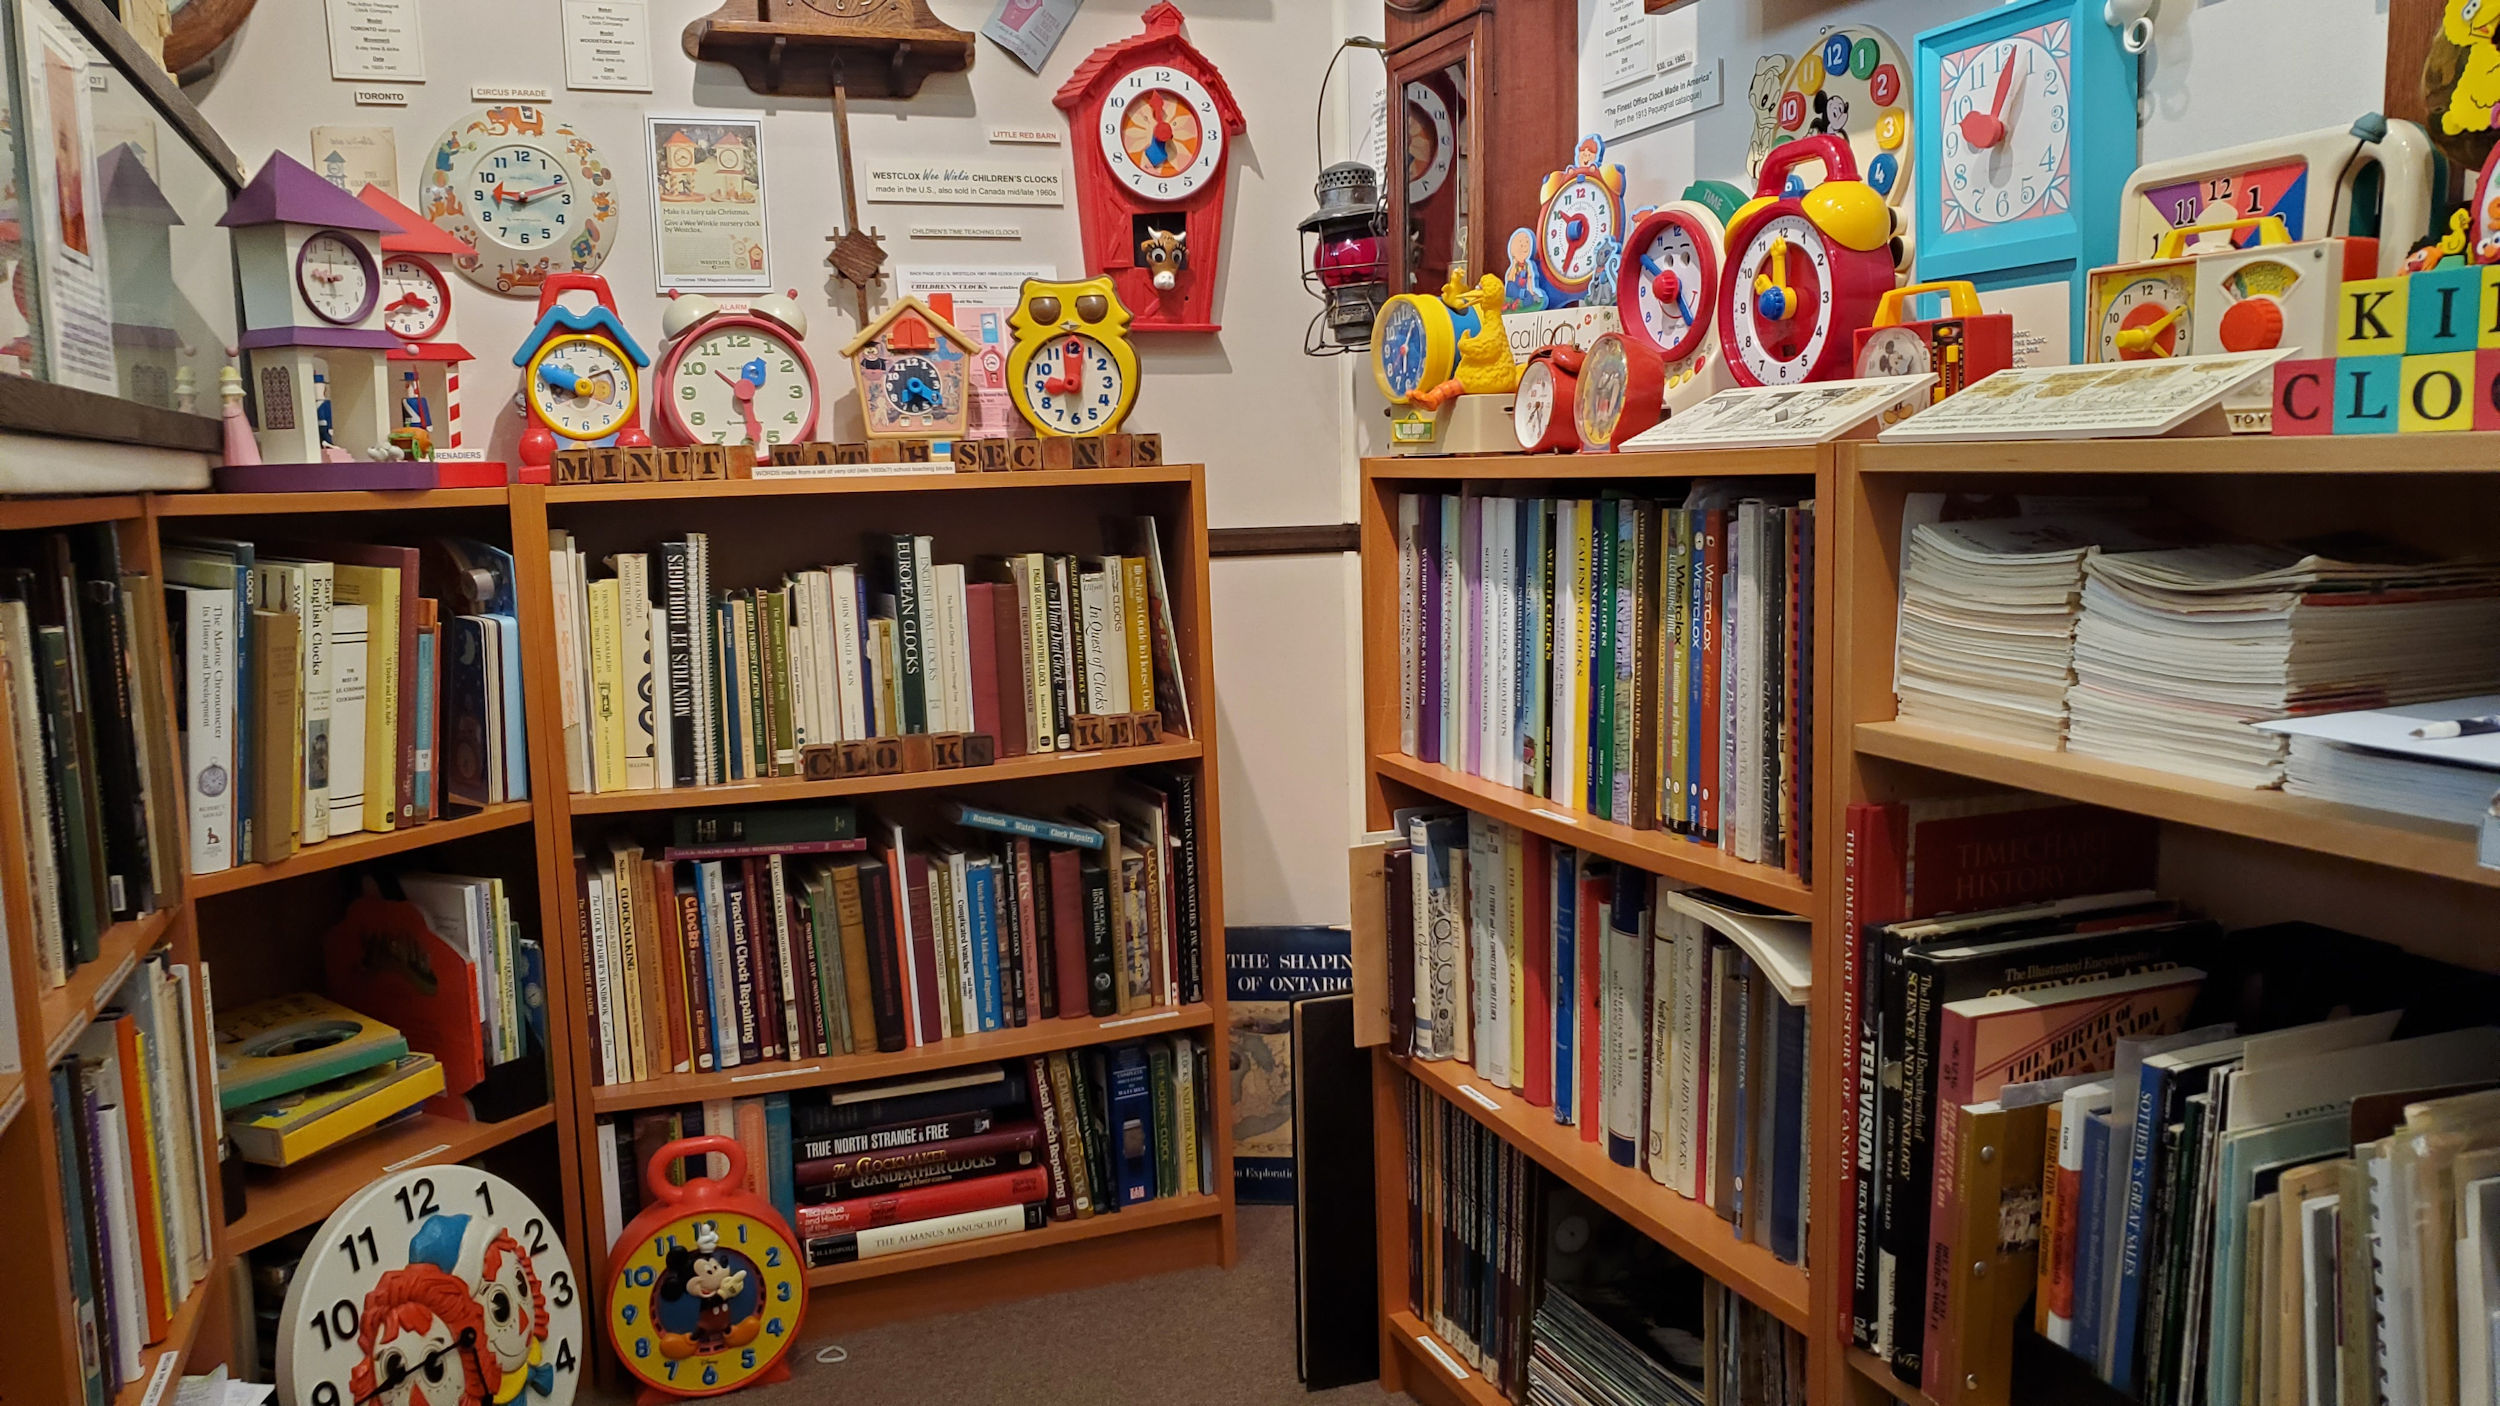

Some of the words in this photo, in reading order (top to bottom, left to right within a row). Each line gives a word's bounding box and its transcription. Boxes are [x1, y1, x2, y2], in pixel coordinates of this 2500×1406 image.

[1826, 42, 1843, 67] 12
[476, 88, 510, 97] CIRCUS
[511, 88, 547, 98] PARADE
[1155, 71, 1171, 82] 12
[1875, 72, 1889, 97] 2
[1968, 62, 1987, 92] 11
[2043, 68, 2060, 98] 2
[358, 91, 404, 102] TORONTO
[1110, 97, 1125, 108] 10
[1616, 101, 1632, 113] Finest
[1632, 95, 1648, 109] Office
[1648, 90, 1664, 102] Clock
[1664, 85, 1679, 96] Made
[1627, 113, 1635, 122] the
[1882, 116, 1895, 139] 3
[2050, 104, 2066, 133] 3
[1945, 131, 1959, 158] 9
[2038, 143, 2057, 173] 4
[872, 171, 921, 180] WESTCLOX
[923, 168, 939, 181] Wee
[972, 174, 1022, 183] CHILDREN'S
[1024, 175, 1058, 184] CLOCKS
[978, 187, 1006, 195] Canada
[1007, 188, 1034, 196] mid/late
[1036, 189, 1057, 197] 1960s
[1952, 163, 1968, 191] 8
[2020, 175, 2036, 204] 5
[2208, 178, 2233, 202] 12
[1703, 189, 1724, 211] TIME
[1995, 190, 2010, 218] 6
[2174, 198, 2196, 226] 11
[2348, 283, 2500, 340] KI
[1510, 316, 1565, 350] caillou
[1036, 363, 1052, 376] 10
[434, 451, 481, 459] RENADIERS
[896, 541, 914, 616] EUROPEAN
[1546, 548, 1554, 598] WELCH
[1577, 536, 1586, 617] CALENDAR
[1590, 527, 1599, 601] AMERICAN
[1601, 531, 1609, 598] AMERICAN
[310, 578, 323, 629] English
[322, 577, 332, 613] Early
[667, 553, 687, 625] HORLOGES
[1673, 564, 1686, 646] Westclox
[1691, 561, 1703, 648] WESTCLOX
[213, 604, 223, 627] The
[1088, 604, 1102, 618] In
[1703, 563, 1715, 652] WESTCLOX
[213, 629, 223, 667] Marine
[672, 630, 688, 648] ET
[902, 618, 919, 675] CLOCKS
[1085, 619, 1104, 653] Quest
[1545, 601, 1553, 662] CLOCKS
[1576, 617, 1584, 678] CLOCKS
[1589, 602, 1598, 659] CLOCKS
[312, 632, 323, 677] Clocks
[1087, 656, 1105, 671] of
[672, 653, 691, 718] MONTRES
[1092, 671, 1109, 711] Clocks
[212, 669, 224, 739] Chronometer
[1050, 828, 1068, 839] Clock
[1845, 829, 1855, 867] THE
[620, 887, 636, 972] CLOCKMAKING
[730, 890, 743, 945] Practical
[957, 899, 969, 945] Complicated
[1843, 875, 1855, 985] TIMECHART
[735, 945, 751, 980] Clock
[960, 945, 970, 975] Watches
[1227, 953, 1269, 969] THE
[2004, 968, 2026, 982] The
[1237, 976, 1262, 991] OF
[1920, 974, 1933, 998] The
[739, 981, 755, 1044] Repairing
[1905, 971, 1919, 1037] SCIENCE
[1842, 990, 1853, 1071] HISTORY
[1918, 998, 1931, 1058] Illustrated
[1903, 1040, 1917, 1075] AND
[1034, 1057, 1051, 1109] Practical
[1841, 1077, 1850, 1103] OF
[1857, 1040, 1876, 1172] TELEVISION
[805, 1142, 832, 1159] TRUE
[834, 1135, 869, 1156] NORTH
[871, 1129, 918, 1150] STRANGE
[918, 1131, 925, 1142] &
[925, 1123, 950, 1140] FREE
[1044, 1103, 1058, 1145] Watch
[1887, 1115, 1896, 1146] JOHN
[1900, 1075, 1915, 1181] TECHNOLOGY
[1913, 1124, 1923, 1142] of
[2133, 1091, 2153, 1181] SOTHEBY'S
[1679, 1115, 1691, 1170] CLOCKS
[1840, 1109, 1851, 1181] CANADA
[833, 1162, 851, 1179] The
[948, 1155, 997, 1173] CLOCKS
[1049, 1143, 1067, 1200] Repairing
[1885, 1147, 1895, 1180] WARE
[394, 1177, 440, 1223] 12
[475, 1180, 494, 1217] 1
[1857, 1179, 1868, 1209] RICK
[1884, 1182, 1893, 1230] WILLARD
[2128, 1180, 2144, 1226] GREAT
[805, 1205, 845, 1219] Technique
[805, 1215, 821, 1226] and
[821, 1212, 850, 1225] History
[339, 1226, 379, 1273] 11
[523, 1217, 549, 1256] 2
[874, 1236, 894, 1248] THE
[899, 1230, 945, 1245] ALMANUS
[947, 1218, 1009, 1240] MANUSCRIPT
[765, 1246, 781, 1267] 2
[1855, 1211, 1868, 1291] MARSCHALL
[2124, 1227, 2140, 1278] SALES
[550, 1270, 574, 1308] 3
[623, 1265, 656, 1288] 10
[776, 1280, 792, 1302] 3
[310, 1298, 359, 1351] 10
[555, 1337, 576, 1374] 4
